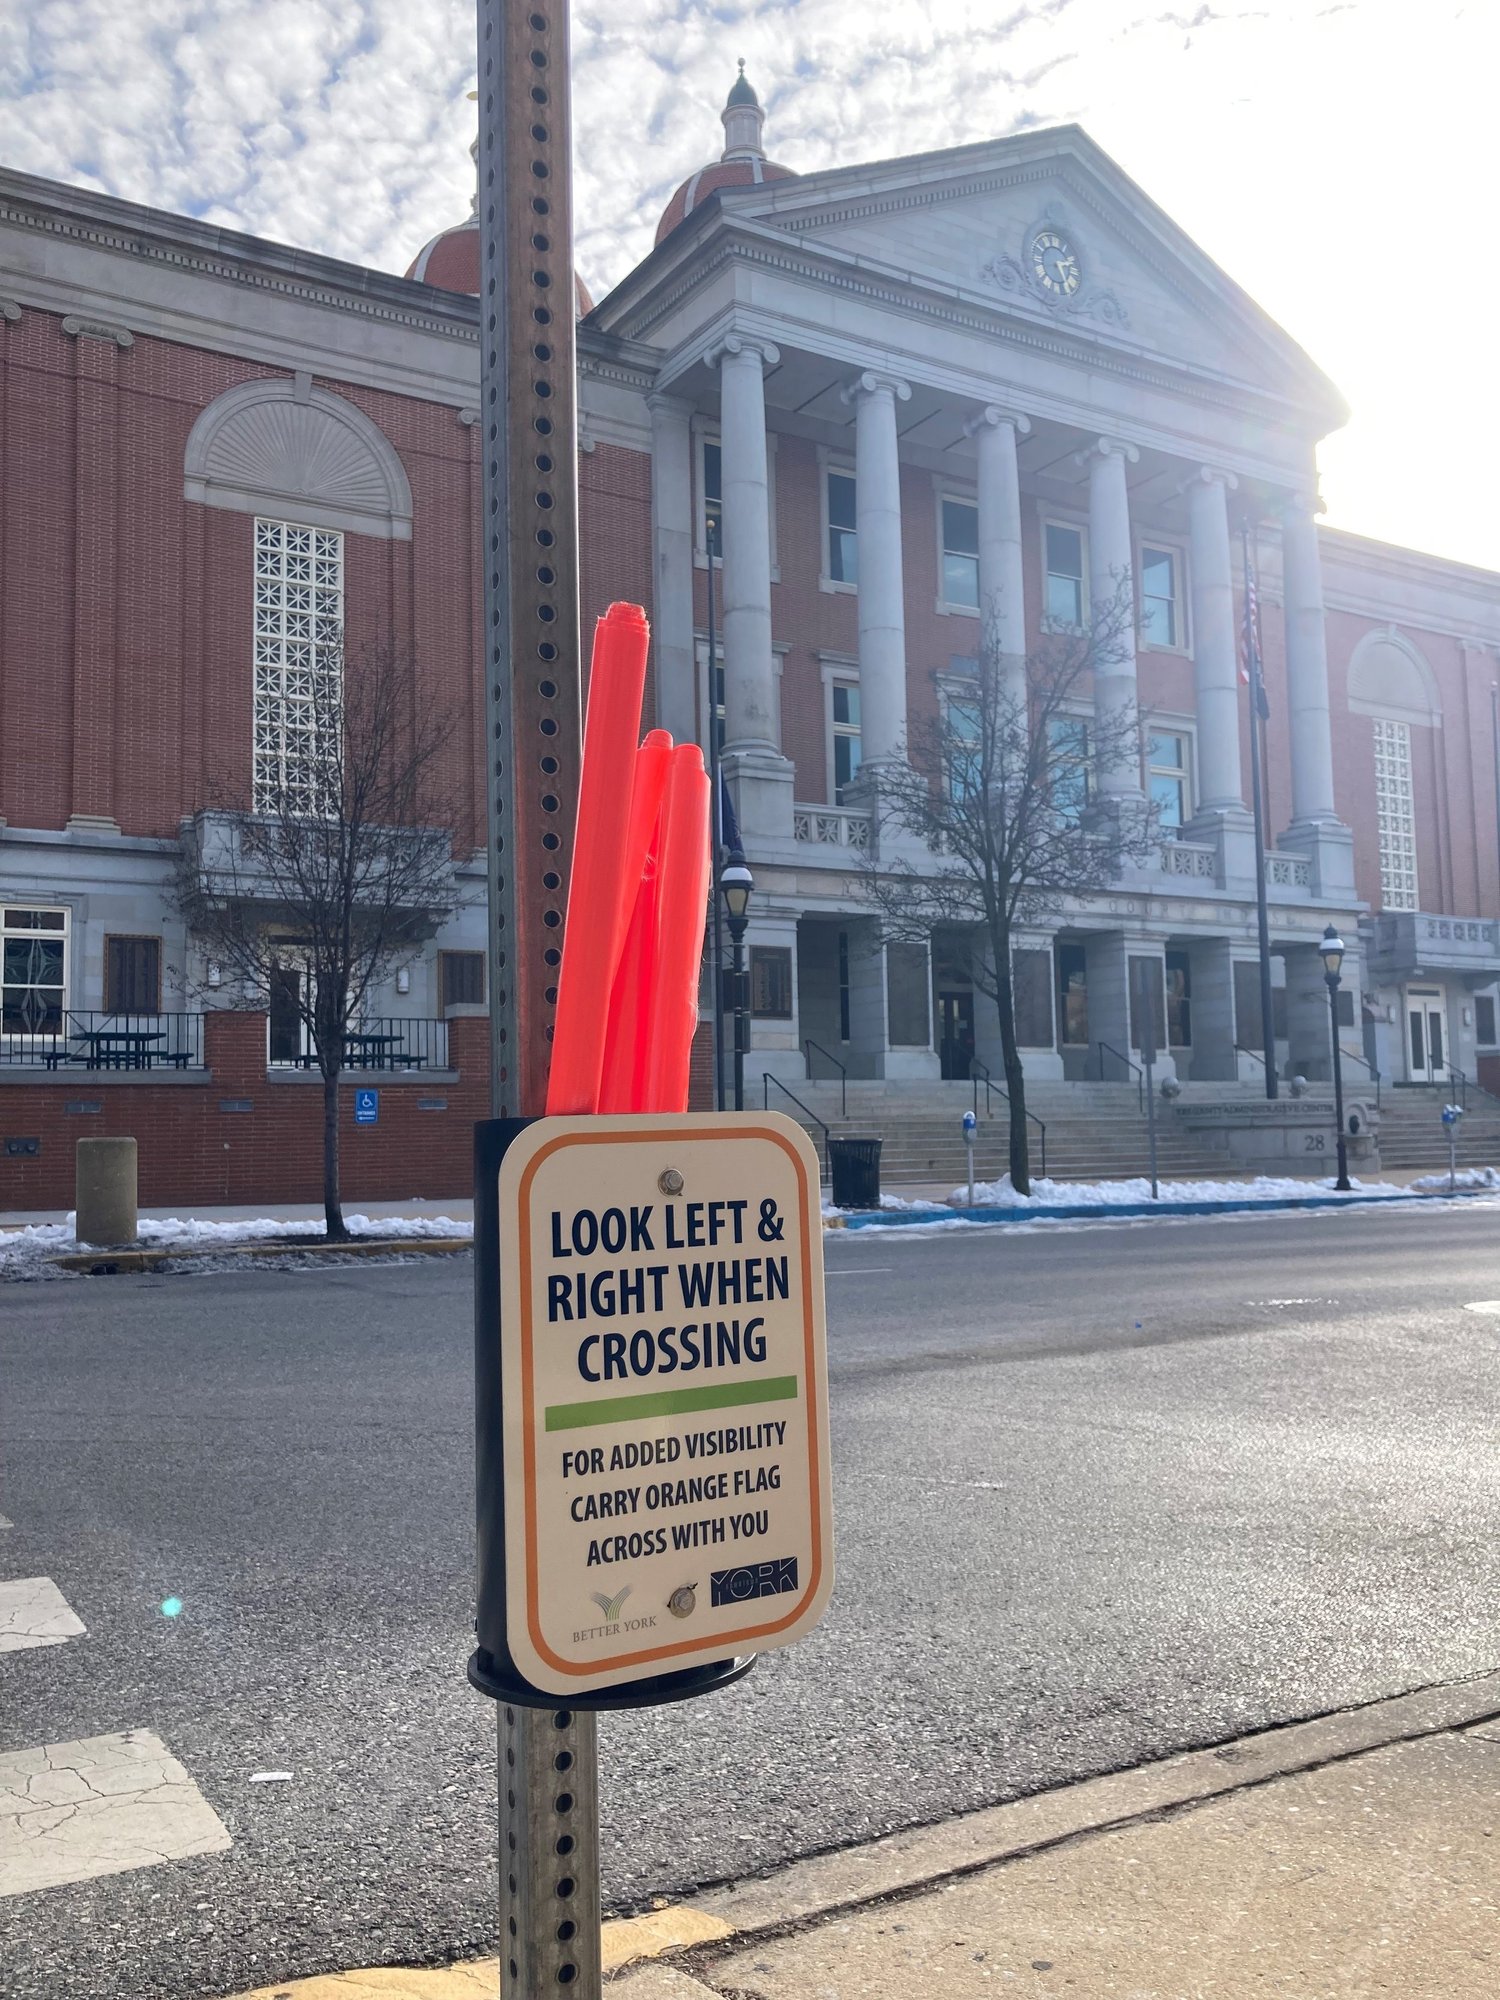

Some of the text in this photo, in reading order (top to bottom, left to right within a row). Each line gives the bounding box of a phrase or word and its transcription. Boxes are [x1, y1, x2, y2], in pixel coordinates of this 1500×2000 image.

[1304, 1134, 1325, 1151] 28
[551, 1198, 785, 1258] LOOK LEFT &
[547, 1256, 789, 1322] RIGHT WHEN
[577, 1317, 767, 1383] CROSSING
[562, 1421, 786, 1478] FOR ADDED VISIBILITY
[570, 1465, 781, 1522] CARRY ORANGE FLAG
[586, 1509, 769, 1566] ACROSS WITH YOU
[710, 1555, 798, 1607] YORK
[573, 1615, 657, 1643] BETTER YORK
